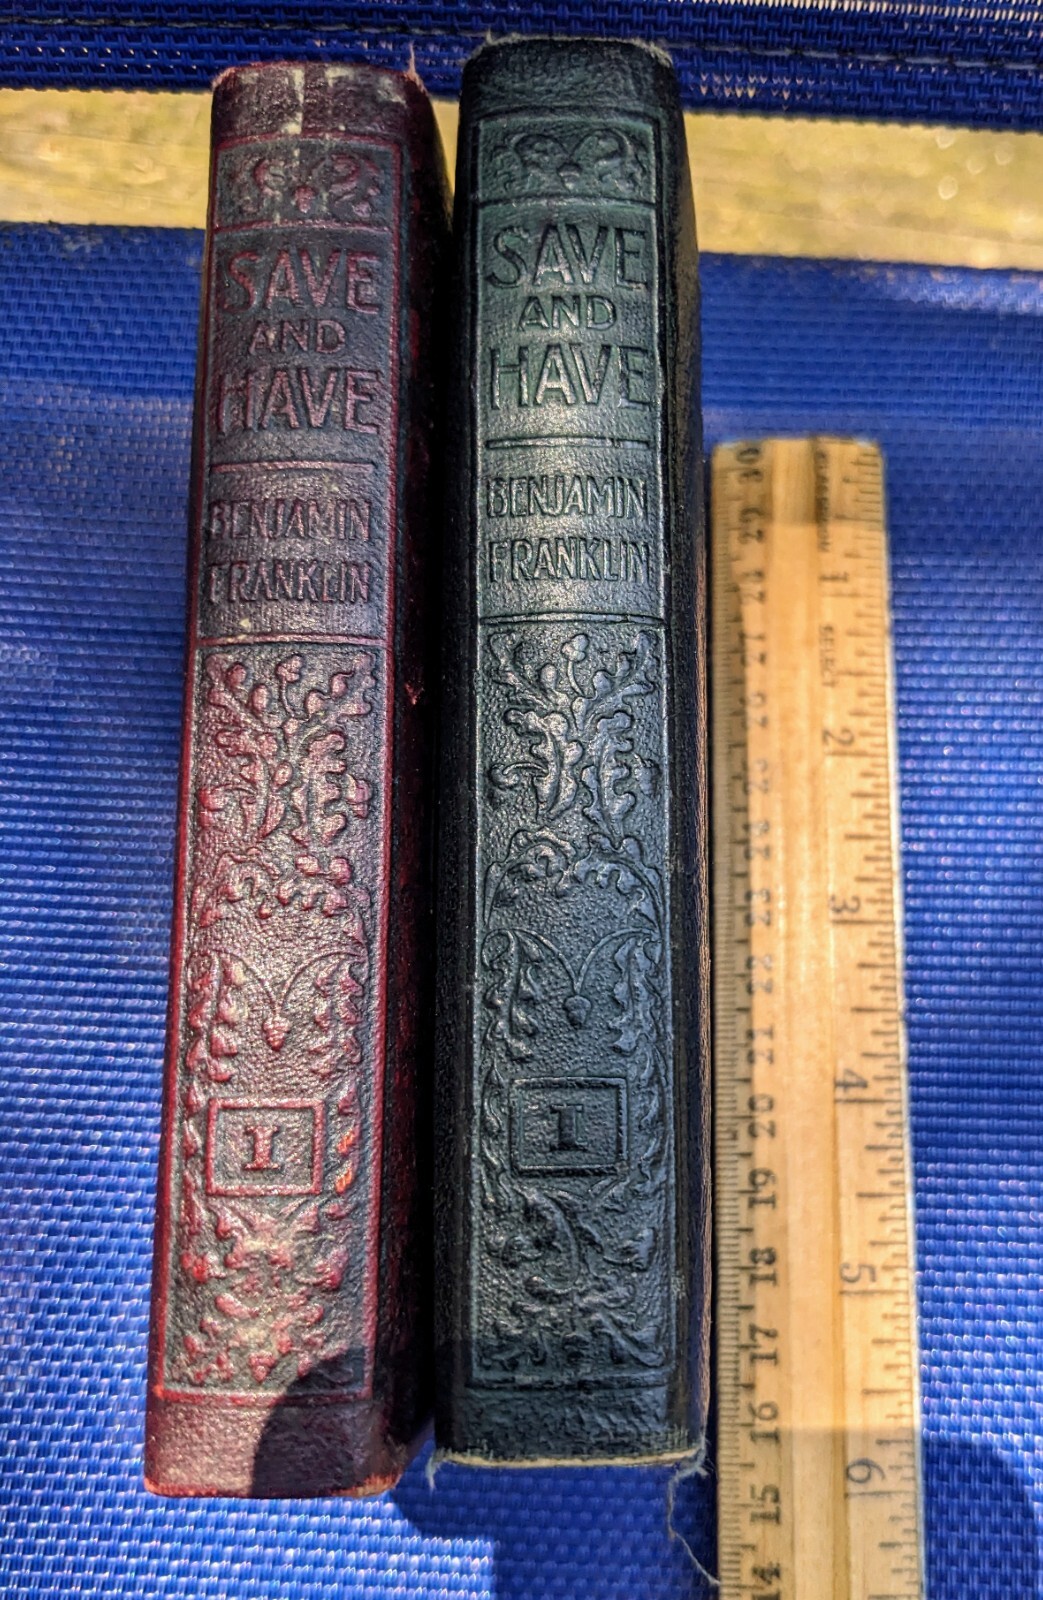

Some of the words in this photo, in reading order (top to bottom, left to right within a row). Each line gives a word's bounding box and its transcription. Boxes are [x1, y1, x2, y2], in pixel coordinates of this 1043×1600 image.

[484, 222, 649, 291] SAVE
[222, 247, 381, 315] SAVE
[517, 294, 619, 333] AND
[249, 318, 346, 355] AND
[488, 342, 651, 411] HAVE
[215, 367, 382, 437] HAVE
[486, 474, 649, 519] BENJAMIN
[209, 500, 371, 542] BENJAMIN
[209, 558, 371, 602] FRANKLIN
[488, 536, 650, 584] FRANKLIN
[819, 570, 848, 583] 1
[822, 727, 855, 747] 2
[829, 893, 861, 914] 3
[747, 1024, 775, 1065] 21
[834, 1067, 868, 1093] 4
[550, 1103, 588, 1153] I
[748, 1092, 776, 1139] 20
[243, 1125, 278, 1171] I
[748, 1167, 777, 1210] 19
[750, 1246, 777, 1287] 18
[840, 1262, 876, 1284] 5
[750, 1322, 779, 1366] 17
[750, 1400, 780, 1443] 16
[845, 1456, 886, 1485] 6
[751, 1483, 781, 1525] 15
